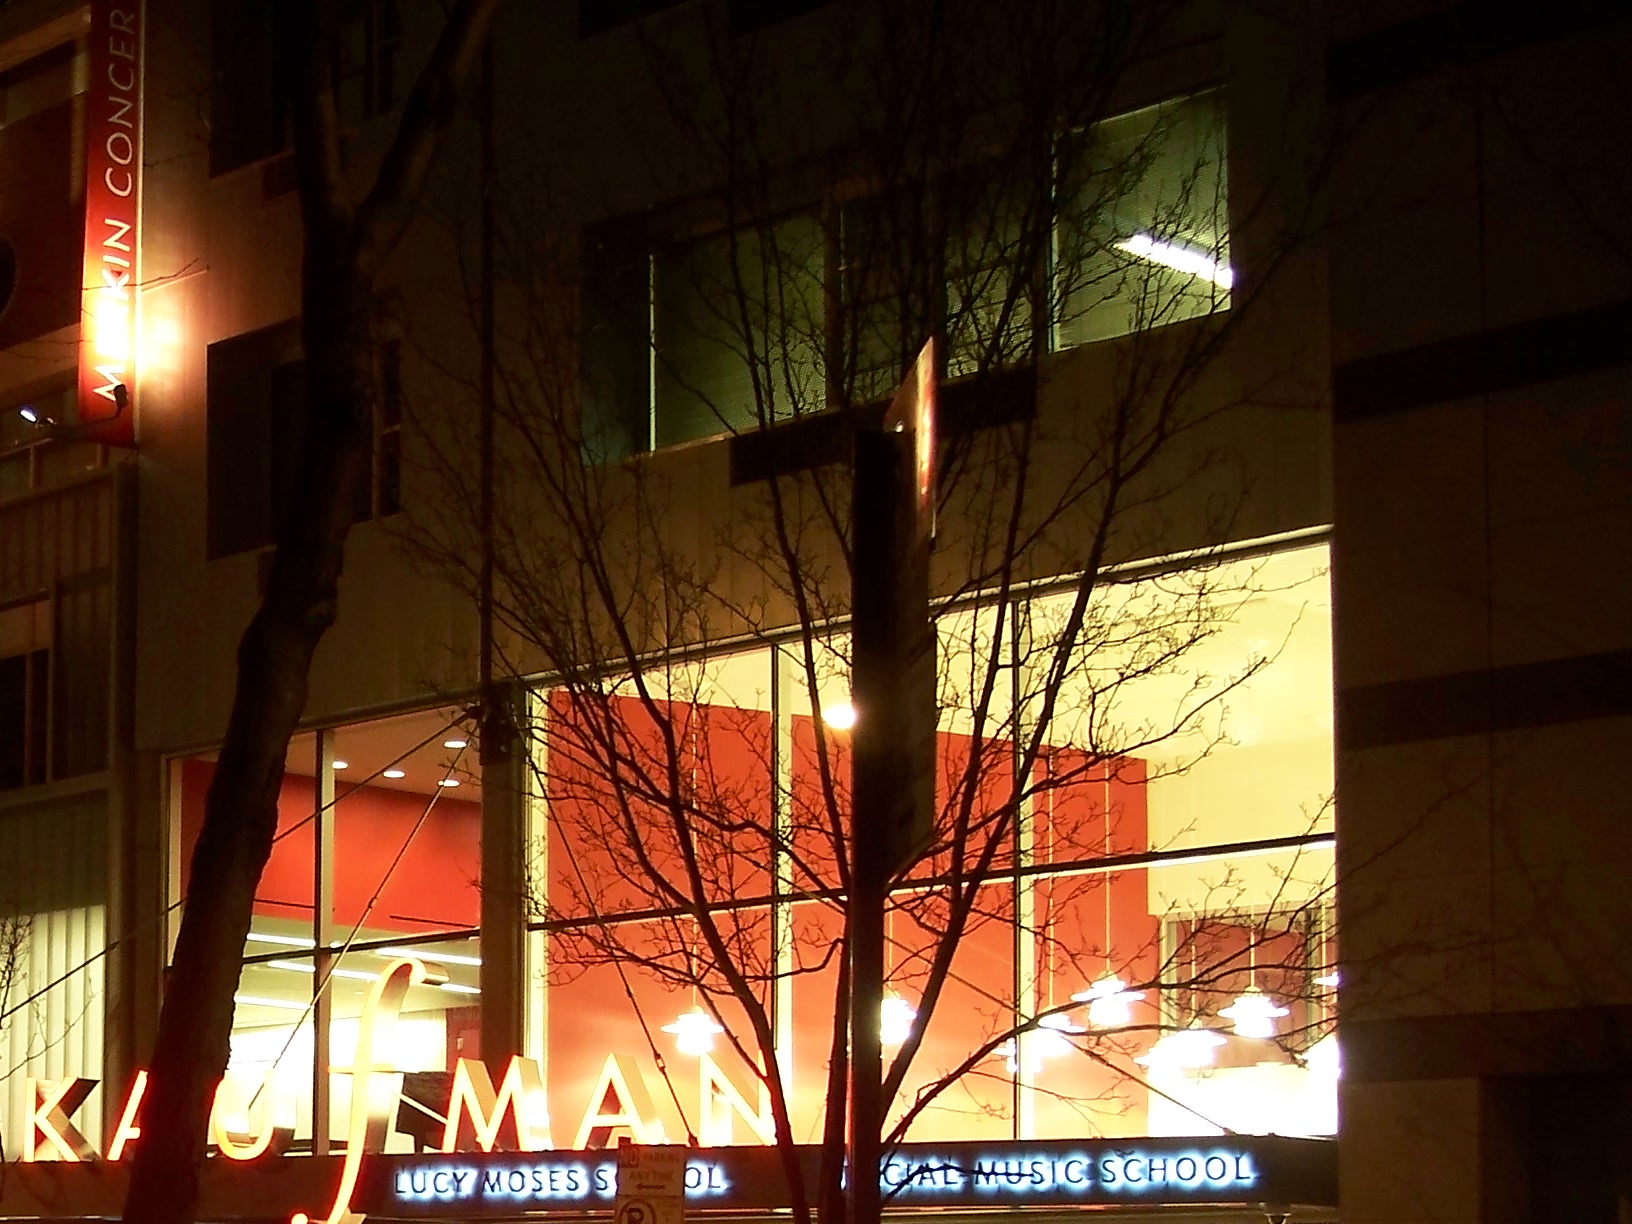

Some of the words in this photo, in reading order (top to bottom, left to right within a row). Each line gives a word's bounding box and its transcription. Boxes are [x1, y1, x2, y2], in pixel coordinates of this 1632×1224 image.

[105, 0, 134, 197] CONCER
[93, 218, 131, 402] MKIN
[394, 1171, 471, 1194] LUCY
[482, 1168, 580, 1194] MOSES
[596, 1166, 722, 1193] SOL
[974, 1158, 1086, 1186] MUSIC
[1101, 1155, 1252, 1184] SCHOOL
